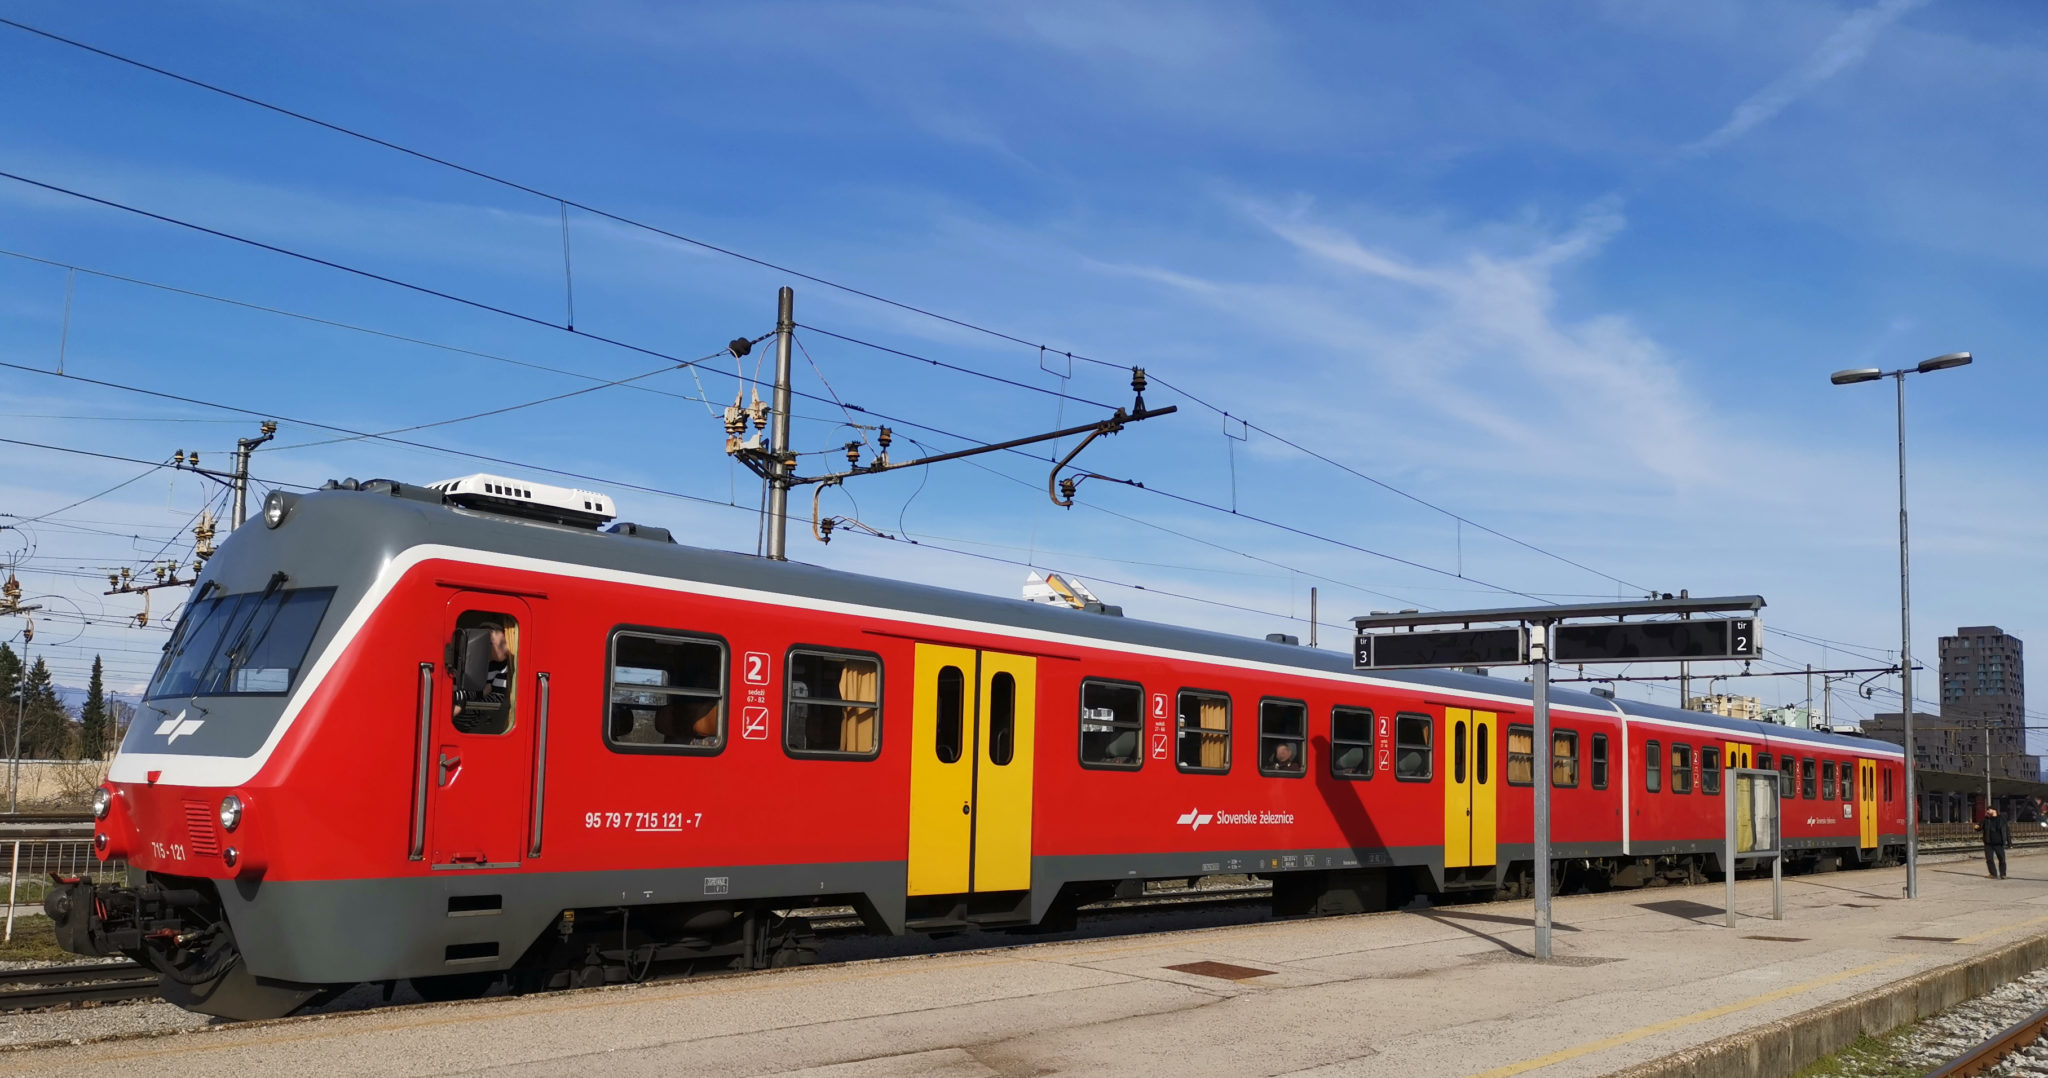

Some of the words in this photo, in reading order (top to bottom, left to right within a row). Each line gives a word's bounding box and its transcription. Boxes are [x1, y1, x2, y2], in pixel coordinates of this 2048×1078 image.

[1737, 621, 1747, 630] tir
[1737, 636, 1747, 651] 2
[1359, 650, 1367, 663] 3
[747, 655, 762, 681] 2
[1154, 696, 1164, 715] 2
[1380, 719, 1387, 735] 2
[585, 812, 602, 828] 95
[605, 812, 621, 828] 79
[624, 812, 633, 828] 7
[635, 812, 658, 828] 715
[662, 812, 682, 828] 121
[694, 812, 703, 828] 7
[1216, 810, 1258, 825] Slovenske
[1259, 810, 1294, 825] železnice
